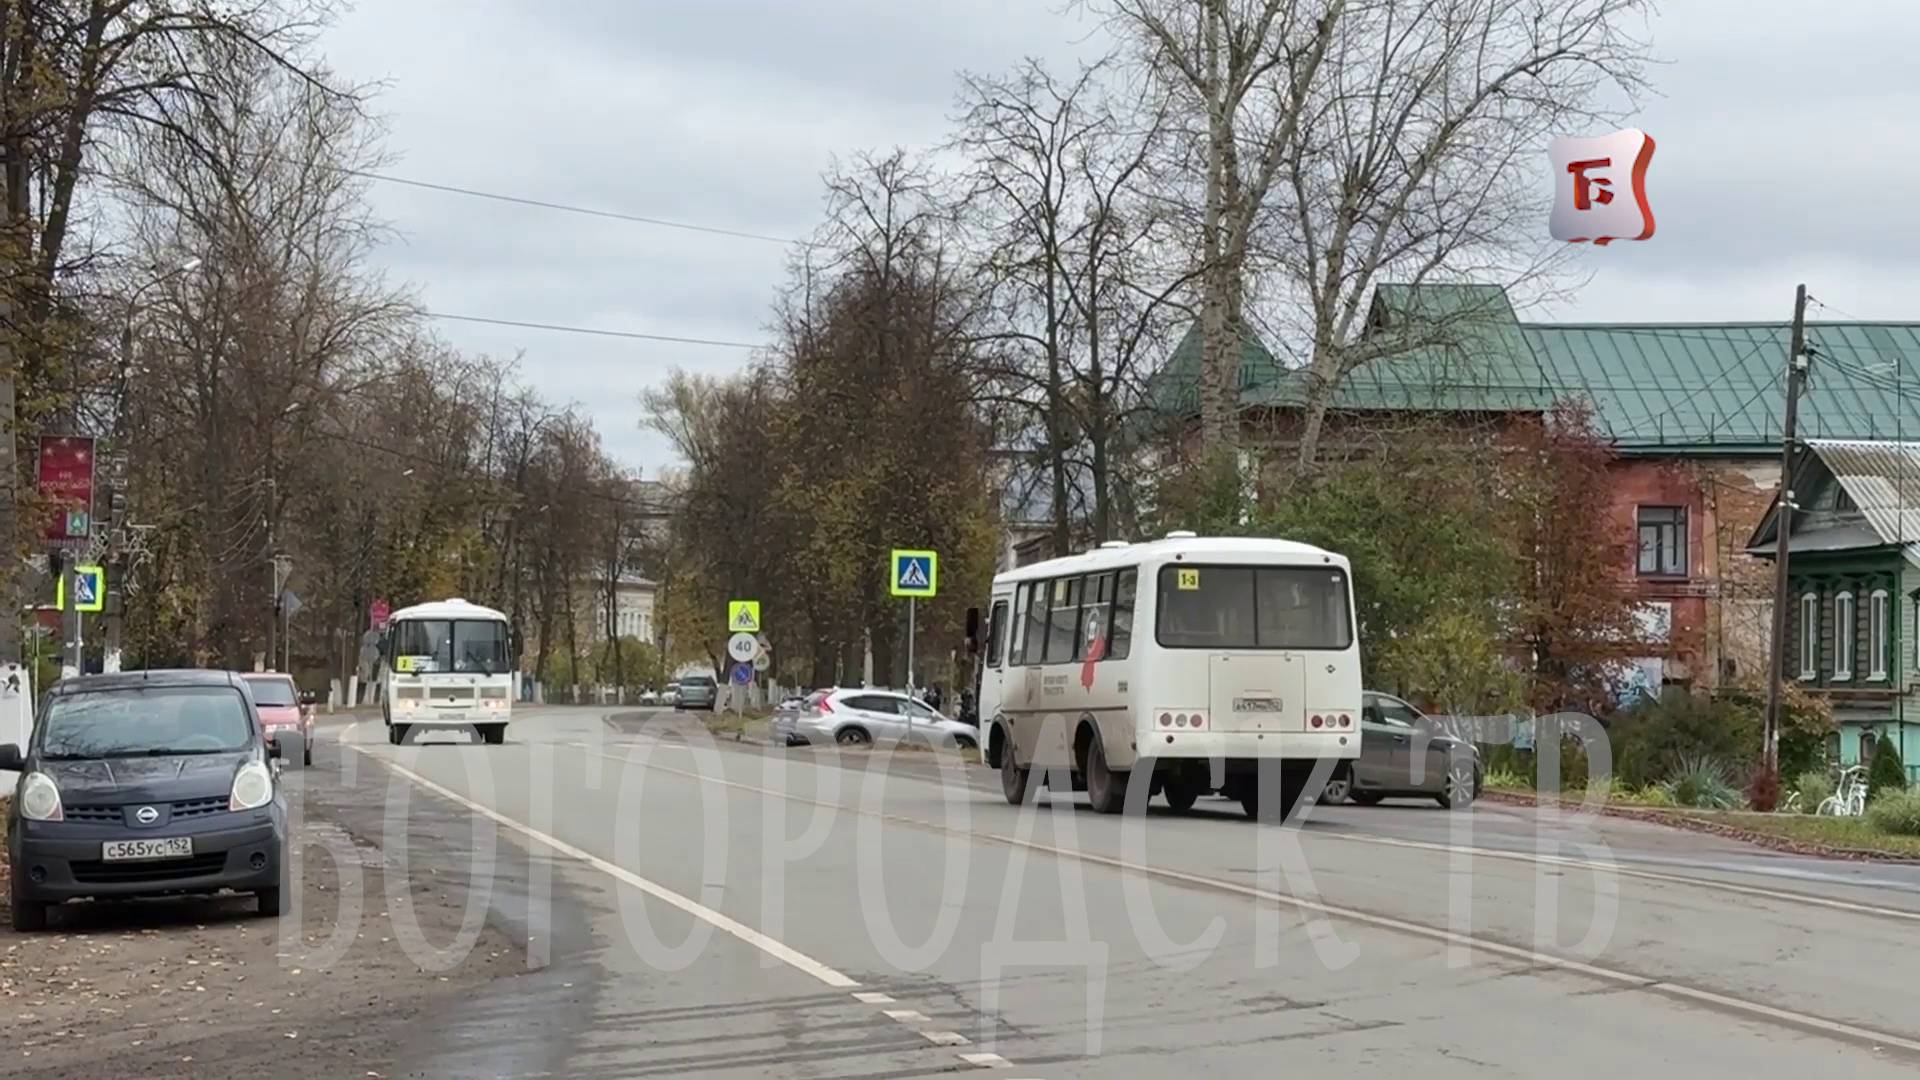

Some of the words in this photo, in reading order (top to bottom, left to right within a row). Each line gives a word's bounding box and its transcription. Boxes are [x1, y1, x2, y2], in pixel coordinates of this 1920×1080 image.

[736, 641, 752, 653] 40
[107, 842, 163, 857] С565УС
[166, 839, 188, 850] 152
